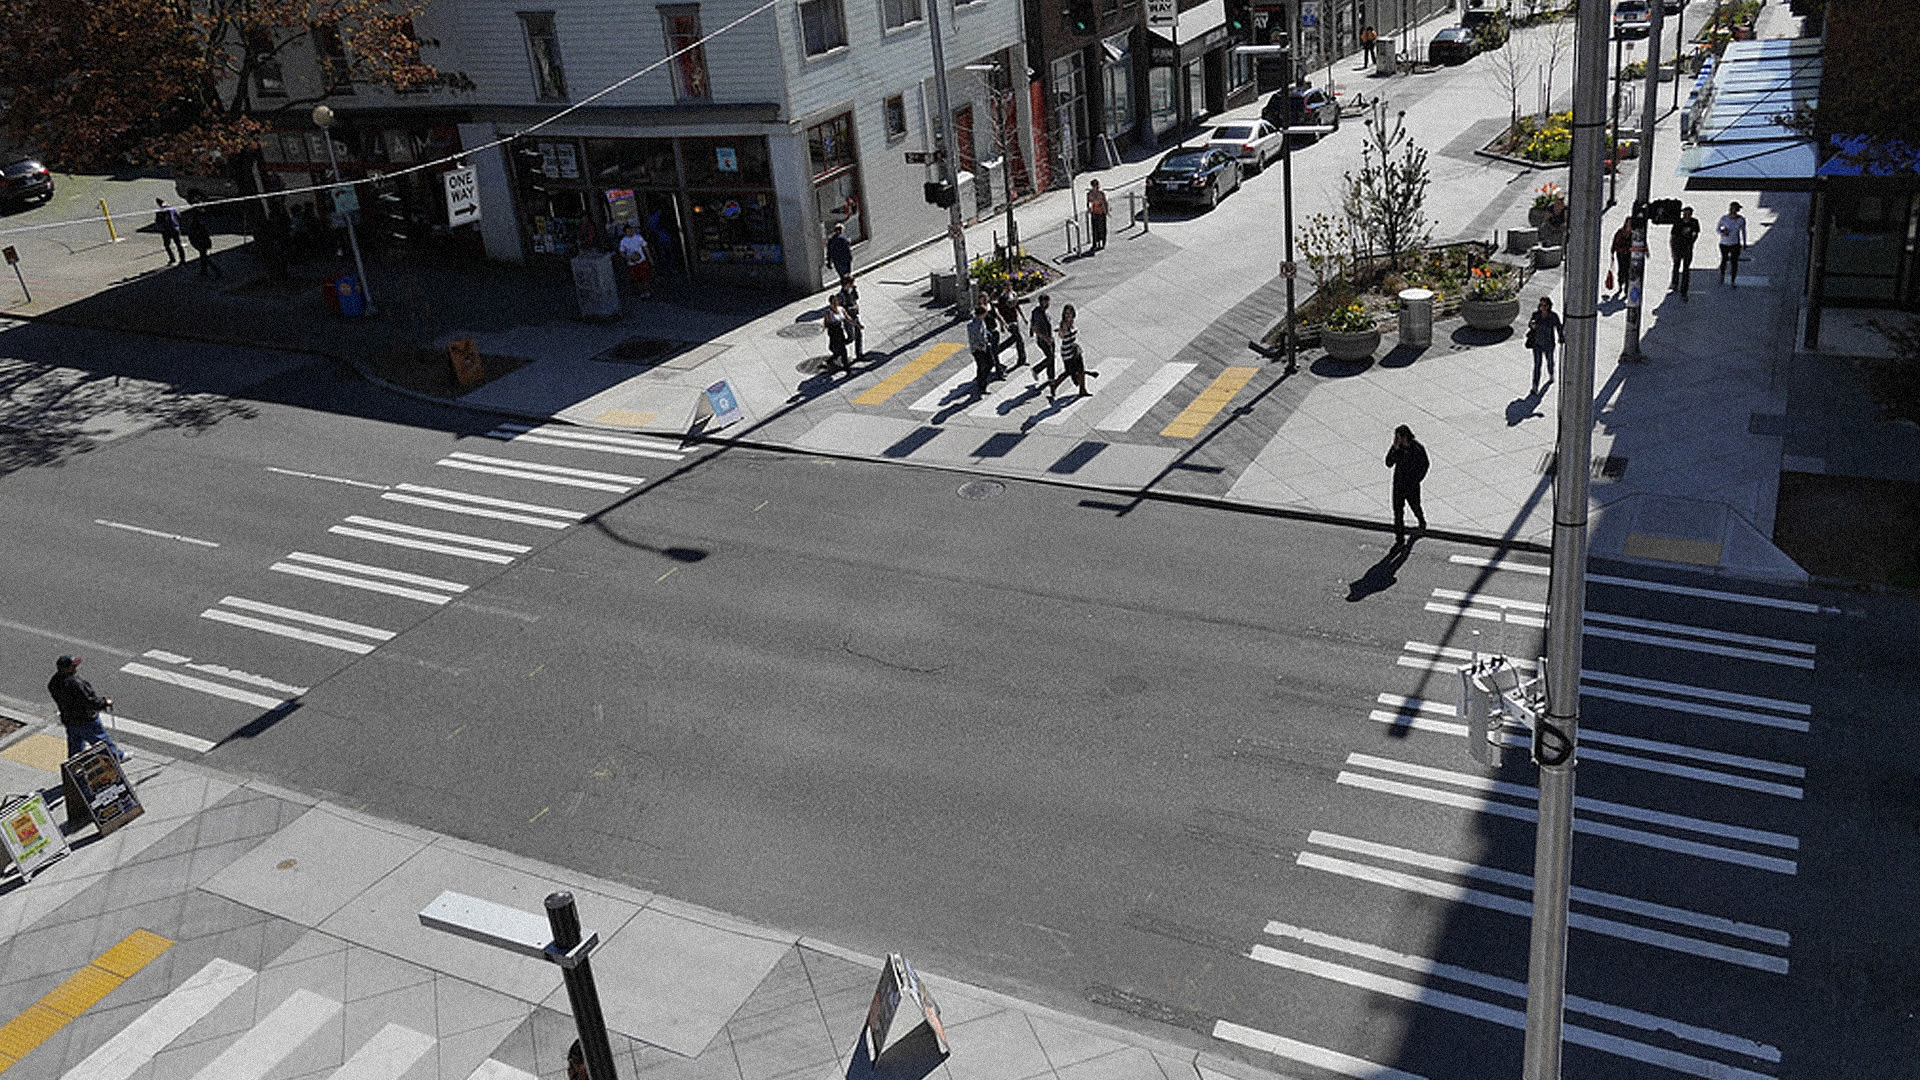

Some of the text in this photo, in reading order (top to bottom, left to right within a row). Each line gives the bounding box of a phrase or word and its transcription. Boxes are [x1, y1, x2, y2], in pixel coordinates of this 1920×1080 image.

[1148, 4, 1172, 12] WAY
[449, 172, 473, 188] ONE
[451, 186, 475, 202] WAY
